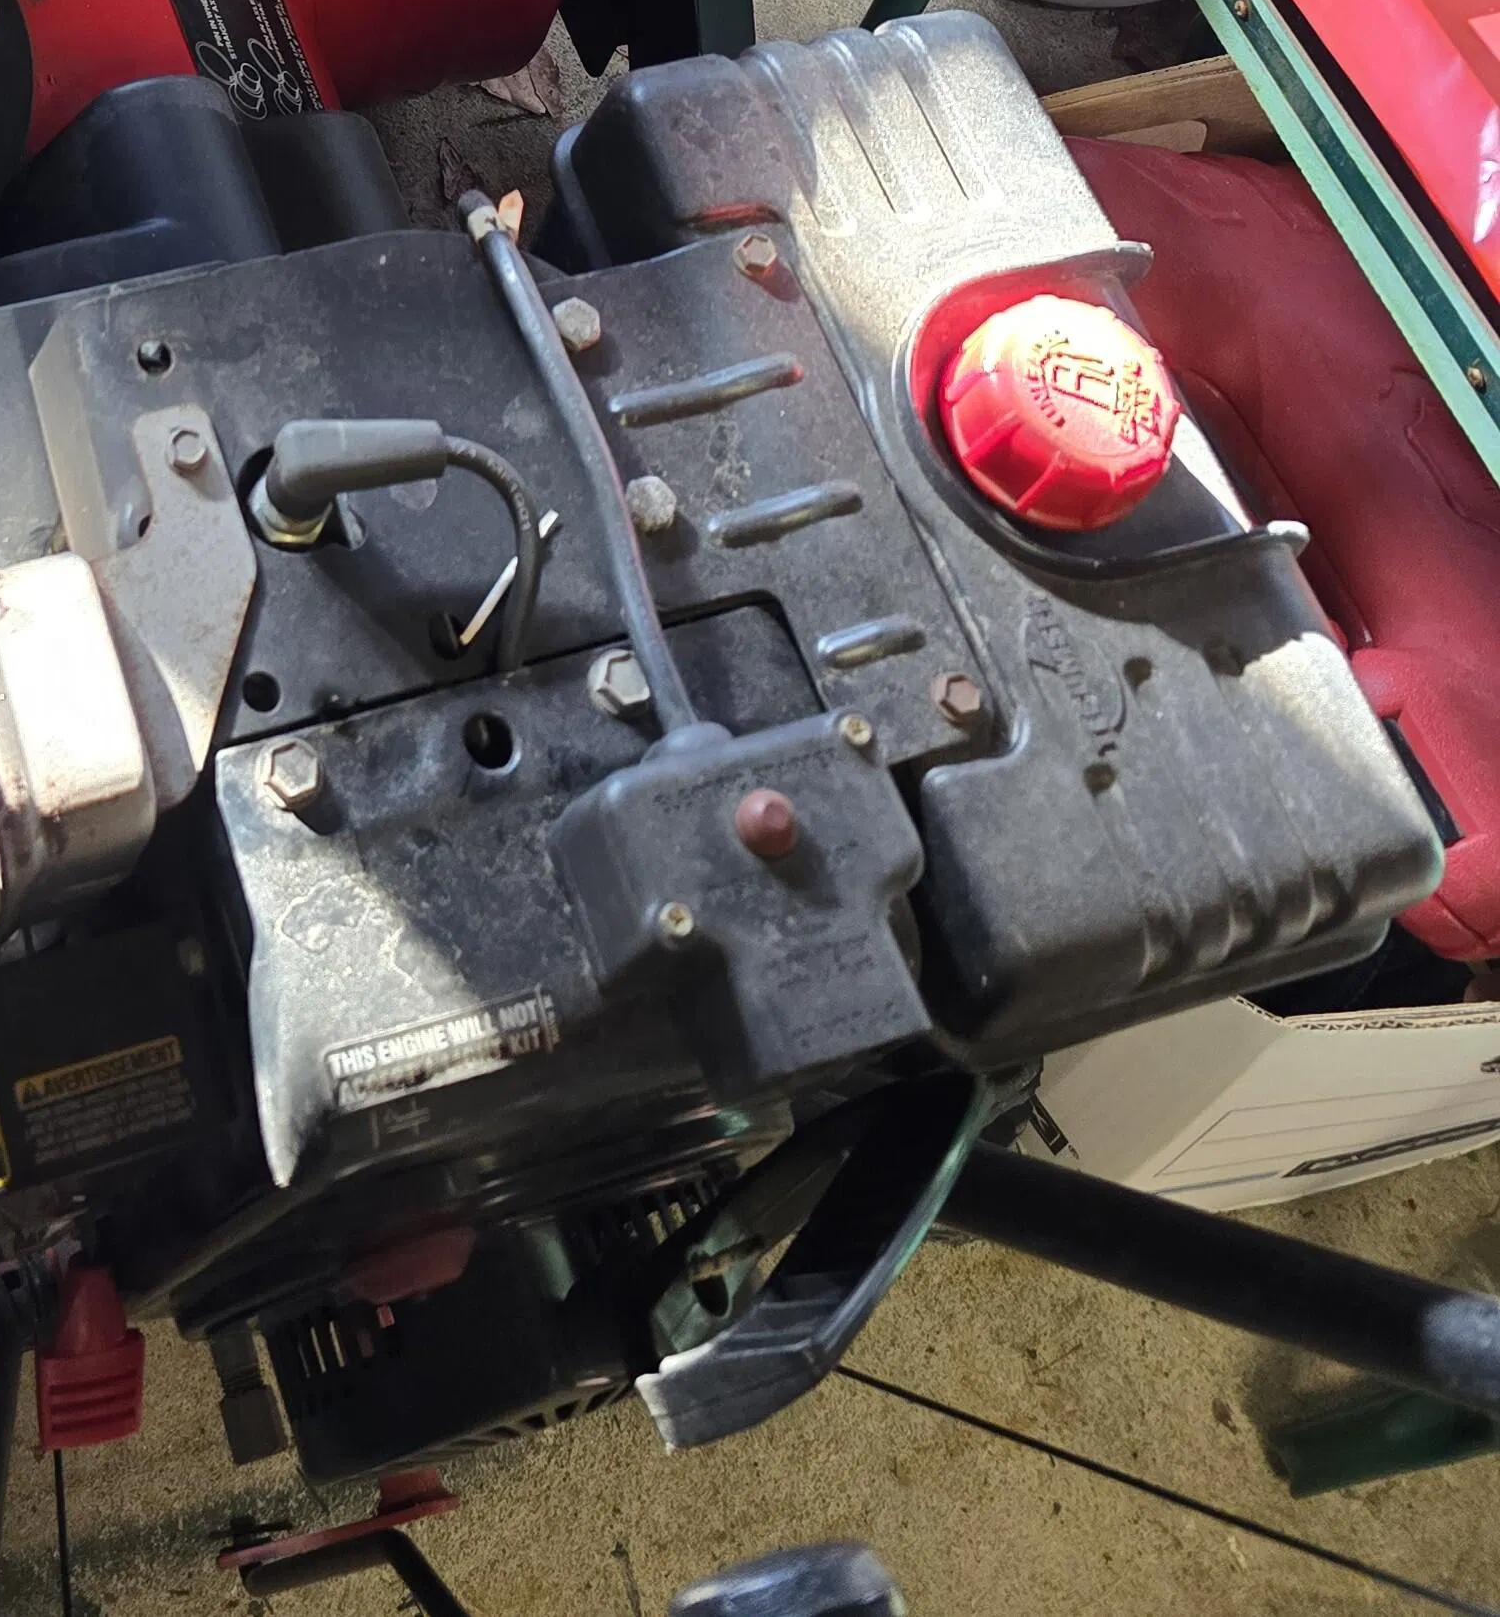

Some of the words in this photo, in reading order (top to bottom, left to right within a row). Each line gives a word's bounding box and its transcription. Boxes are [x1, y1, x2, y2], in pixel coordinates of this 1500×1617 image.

[214, 13, 237, 59] STRAIGHT
[326, 1042, 378, 1080] THIS
[374, 1022, 450, 1066] ENGINE
[446, 1009, 498, 1046] WILL
[497, 997, 539, 1032] NOT
